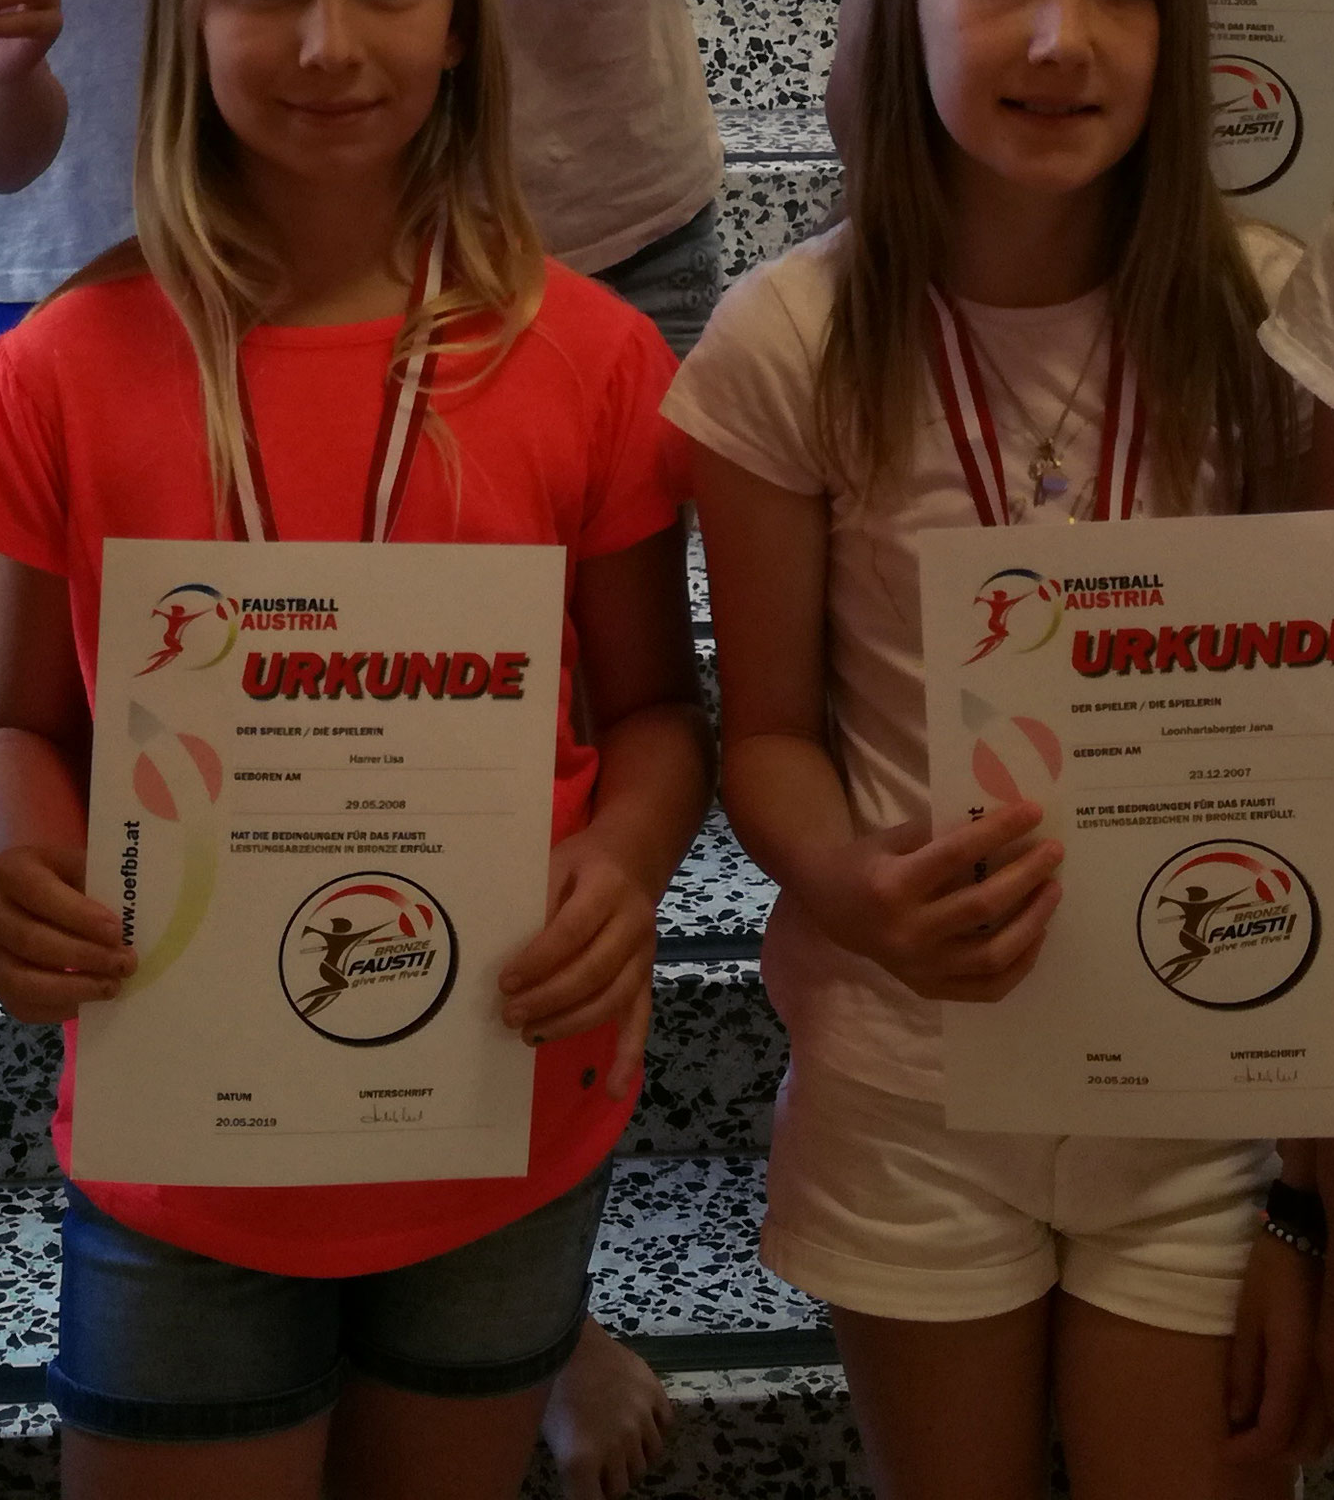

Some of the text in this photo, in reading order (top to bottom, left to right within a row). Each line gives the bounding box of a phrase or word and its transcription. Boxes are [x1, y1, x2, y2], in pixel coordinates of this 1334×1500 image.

[1064, 573, 1164, 592] FAUSTBALL
[241, 598, 339, 613] FAUSTBALL
[1064, 589, 1165, 611] AUSTRIA
[240, 613, 338, 631] AUSTRIA
[241, 652, 529, 700] URKUNDE
[1071, 698, 1222, 713] DER SPIELER DIE SPIELERIN
[236, 727, 384, 736] DER SPIELER DIE SPIELERIN
[1073, 746, 1142, 758] GEBOREN AM
[234, 772, 301, 781] GEBOREN AM
[1076, 805, 1095, 816] HAT
[1098, 805, 1115, 815] DIE
[1117, 802, 1191, 814] BEDINGUNGEN
[1193, 799, 1214, 810] FÜR
[1217, 798, 1238, 809] DAS
[1077, 815, 1190, 829] LEISTUNGSABZEICHEN
[1192, 813, 1203, 823] IN
[231, 831, 251, 841] HAT
[252, 831, 269, 841] DIE
[271, 831, 344, 841] BEDINGUNGEN
[347, 830, 367, 841] FÜR
[370, 831, 389, 841] DAS
[230, 844, 342, 854] LEISTUNGSABZEICHEN
[1233, 904, 1291, 923] BRONZE
[374, 940, 432, 956] BRONZE
[1086, 1053, 1122, 1062] DATUM
[1230, 1049, 1306, 1060] UNTERSCHRIFT
[217, 1092, 252, 1102] DATUM
[359, 1088, 434, 1099] UNTERSCHRIFT
